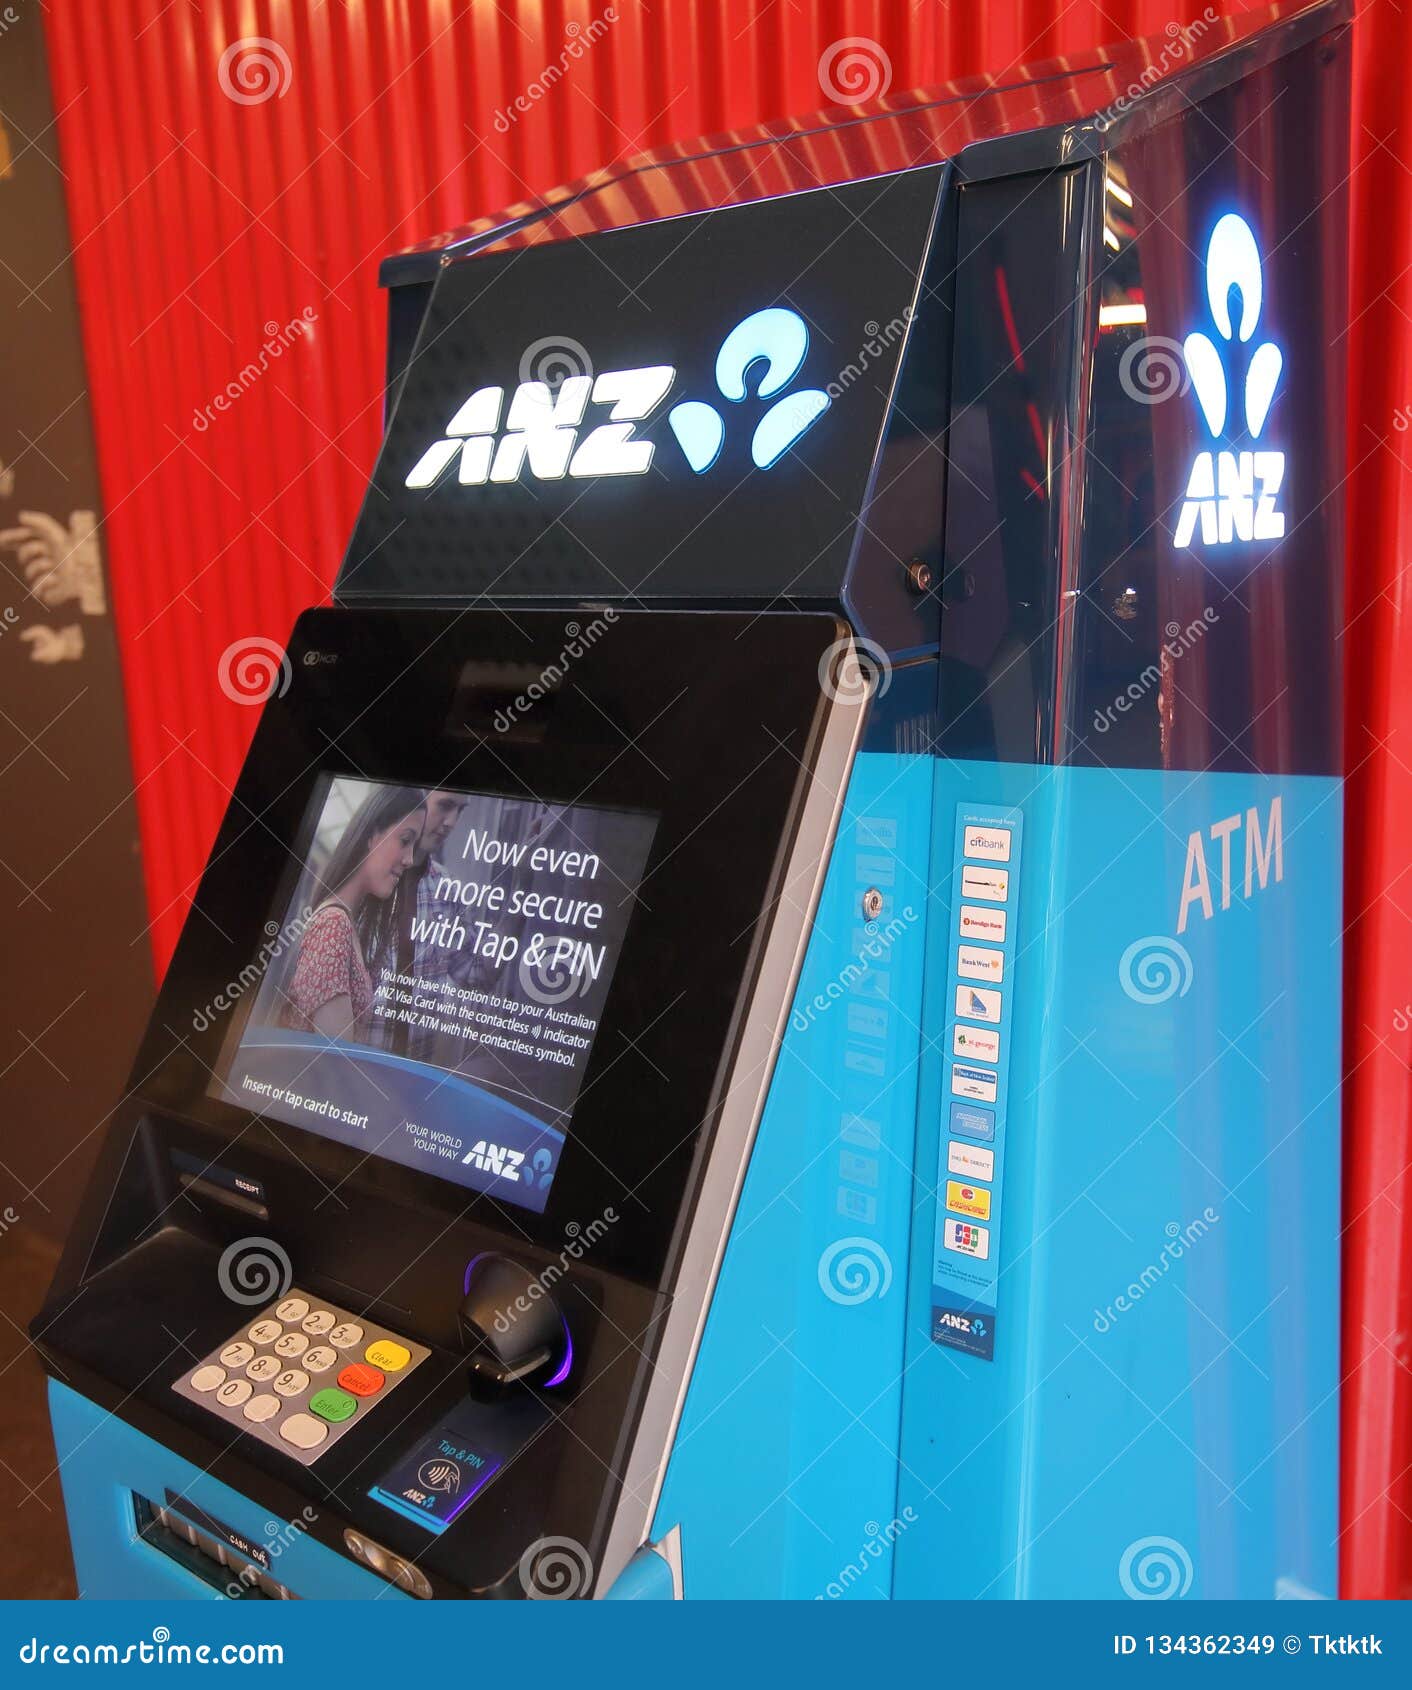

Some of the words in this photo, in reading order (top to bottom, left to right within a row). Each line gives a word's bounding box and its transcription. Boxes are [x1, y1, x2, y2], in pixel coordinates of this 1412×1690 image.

[406, 366, 676, 489] ANZ
[1174, 451, 1286, 548] ANZ
[970, 836, 1004, 849] citibank
[462, 829, 527, 867] Now
[530, 847, 600, 879] even
[1176, 796, 1284, 935] ATM
[434, 877, 505, 911] more
[508, 889, 604, 929] secure
[409, 914, 466, 951] with
[472, 921, 518, 969] Tap
[522, 932, 547, 968] &
[550, 937, 607, 980] PIN
[380, 967, 395, 984] You
[396, 974, 417, 988] now
[417, 975, 440, 993] have
[441, 980, 457, 997] the
[457, 986, 489, 1004] option
[489, 994, 501, 1008] to
[502, 997, 518, 1013] tap
[520, 1002, 544, 1019] your
[543, 1007, 597, 1031] Australian
[374, 985, 395, 1001] ANZ
[395, 988, 413, 1005] Visa
[413, 994, 436, 1011] Card
[436, 999, 457, 1017] with
[458, 1004, 475, 1021] the
[475, 1009, 530, 1035] contactless
[542, 1026, 591, 1049] indicator
[374, 1004, 384, 1017] at
[384, 1007, 397, 1019] an
[396, 1009, 418, 1025] ANZ
[418, 1015, 440, 1031] ATM
[440, 1020, 461, 1038] with
[462, 1026, 479, 1042] the
[479, 1031, 535, 1056] contactless
[534, 1044, 576, 1068] symbol.
[242, 1075, 274, 1099] Insert
[272, 1087, 285, 1101] or
[284, 1089, 303, 1110] tap
[303, 1094, 328, 1116] card
[328, 1103, 341, 1120] to
[340, 1107, 369, 1129] start
[405, 1121, 430, 1139] YOUR
[430, 1129, 462, 1149] WORLD
[413, 1136, 437, 1155] YOUR
[436, 1143, 459, 1161] WAY
[462, 1139, 525, 1182] ANZ
[281, 1303, 294, 1314] 1
[254, 1324, 269, 1336] 4
[305, 1315, 320, 1327] 2
[939, 1313, 971, 1333] ANZ
[278, 1336, 294, 1348] 5
[331, 1326, 348, 1340] 3
[225, 1345, 242, 1357] 7
[307, 1351, 322, 1363] 6
[371, 1351, 393, 1367] Clear
[252, 1359, 267, 1372] 8
[278, 1373, 294, 1386] 9
[223, 1383, 238, 1396] 0
[314, 1399, 339, 1416] Enter
[438, 1439, 457, 1456] Tap
[455, 1449, 467, 1461] &
[465, 1453, 486, 1469] PIN
[402, 1488, 427, 1504] ANZ
[229, 1535, 249, 1552] CASH
